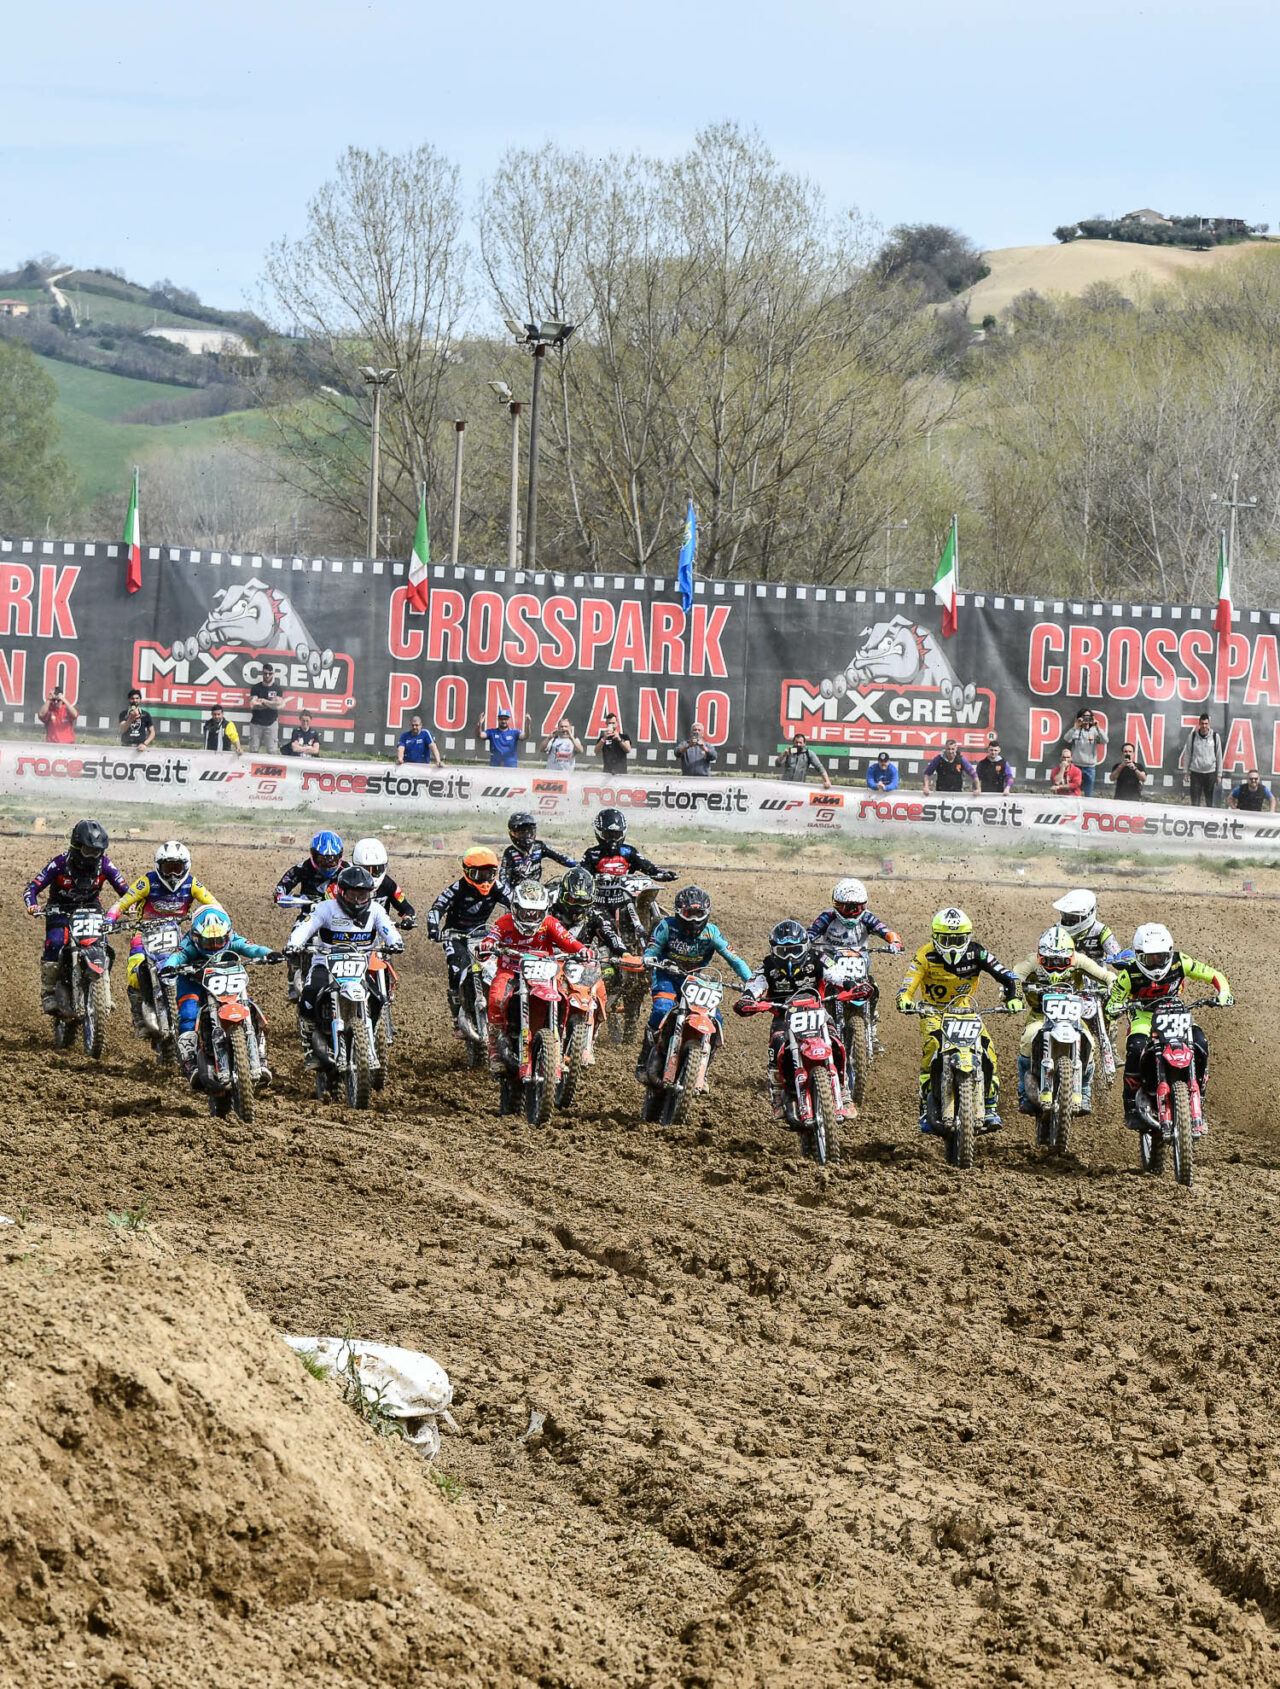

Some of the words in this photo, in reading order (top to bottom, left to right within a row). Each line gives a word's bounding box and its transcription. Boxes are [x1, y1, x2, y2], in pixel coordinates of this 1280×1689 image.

[388, 586, 731, 678] CROSSPARK
[139, 648, 239, 687] MX
[140, 687, 344, 713] LIFESYLE
[386, 672, 731, 747] PONZANO
[787, 686, 886, 723] MX
[888, 697, 983, 724] CREW
[788, 725, 985, 747] LIFESTYLE
[16, 756, 189, 784] racestore.it
[254, 766, 283, 777] KTM
[301, 771, 471, 799] racestore.it
[534, 781, 564, 792] KTM
[581, 785, 750, 812] racestore.it
[812, 795, 841, 805] KTM
[858, 800, 1023, 826] racestore.it
[1081, 812, 1245, 840] racestore.it
[147, 931, 178, 952] 29
[331, 961, 366, 977] 497
[207, 974, 246, 995] 85
[685, 984, 722, 1009] 906
[790, 1010, 825, 1033] 811
[1045, 1001, 1082, 1021] 509
[947, 1021, 981, 1038] 146
